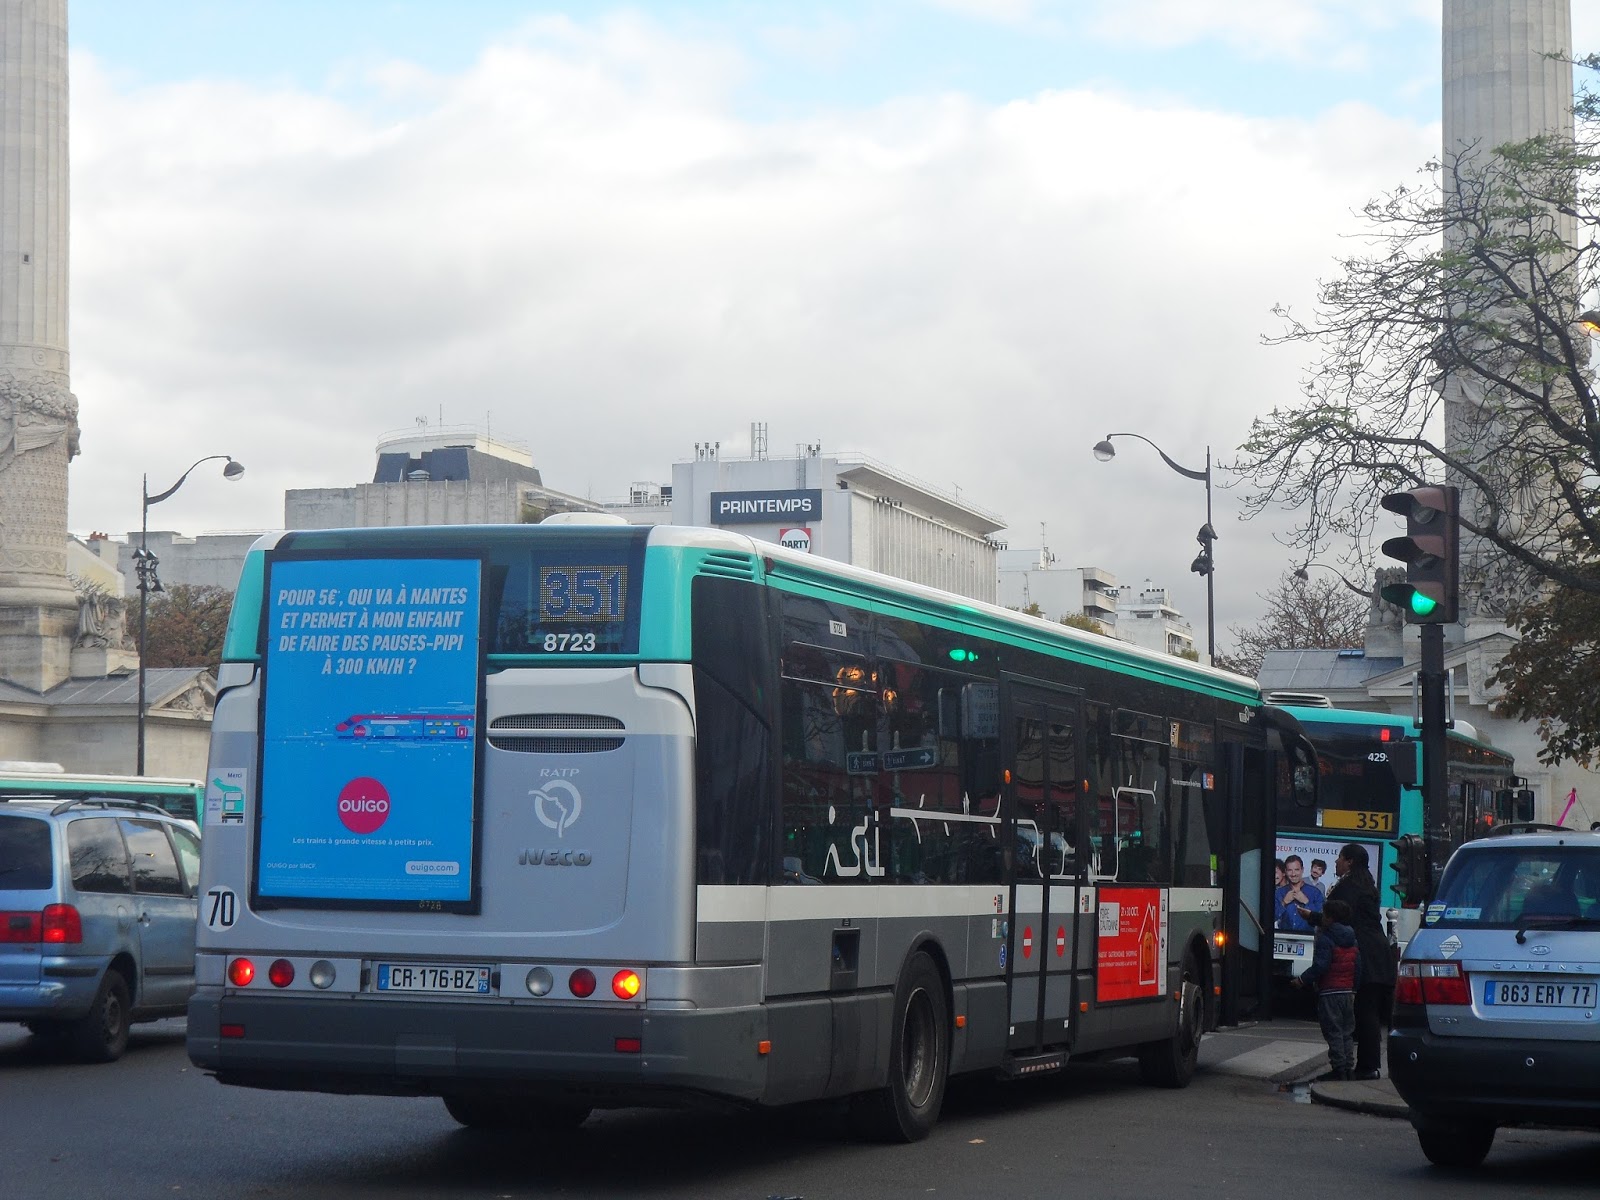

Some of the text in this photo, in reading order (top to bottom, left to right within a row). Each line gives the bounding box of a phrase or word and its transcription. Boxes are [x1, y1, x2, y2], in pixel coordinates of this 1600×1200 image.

[720, 498, 812, 514] PRINTEMPS
[781, 539, 809, 549] DARTY
[278, 589, 316, 606] POUR
[347, 588, 373, 605] QUI
[376, 588, 392, 605] VA
[396, 584, 407, 605] À
[410, 587, 468, 605] NANTES
[545, 571, 620, 617] 351
[280, 607, 464, 629] ET PERMET À MON ENFANT
[278, 634, 464, 652] DE FAIRE DES PAUSES-PIPI
[543, 633, 596, 652] 8723
[321, 654, 417, 674] À 300 KM/H ?
[540, 768, 580, 777] RATP
[1356, 812, 1389, 830] 351
[306, 837, 327, 845] trains
[328, 837, 333, 845] à
[334, 838, 360, 846] grande
[361, 838, 386, 846] vitesse
[388, 838, 393, 846] à
[394, 838, 416, 847] petits
[417, 838, 434, 847] prix.
[1309, 847, 1330, 855] MIEUX
[518, 848, 592, 867] IVECO
[410, 863, 454, 873] ouigo.com
[208, 890, 235, 926] 70
[1492, 962, 1585, 972] CARENS
[391, 968, 476, 989] CR-176-BZ
[478, 980, 488, 991] 75
[1501, 984, 1590, 1005] 863 ERY 77
